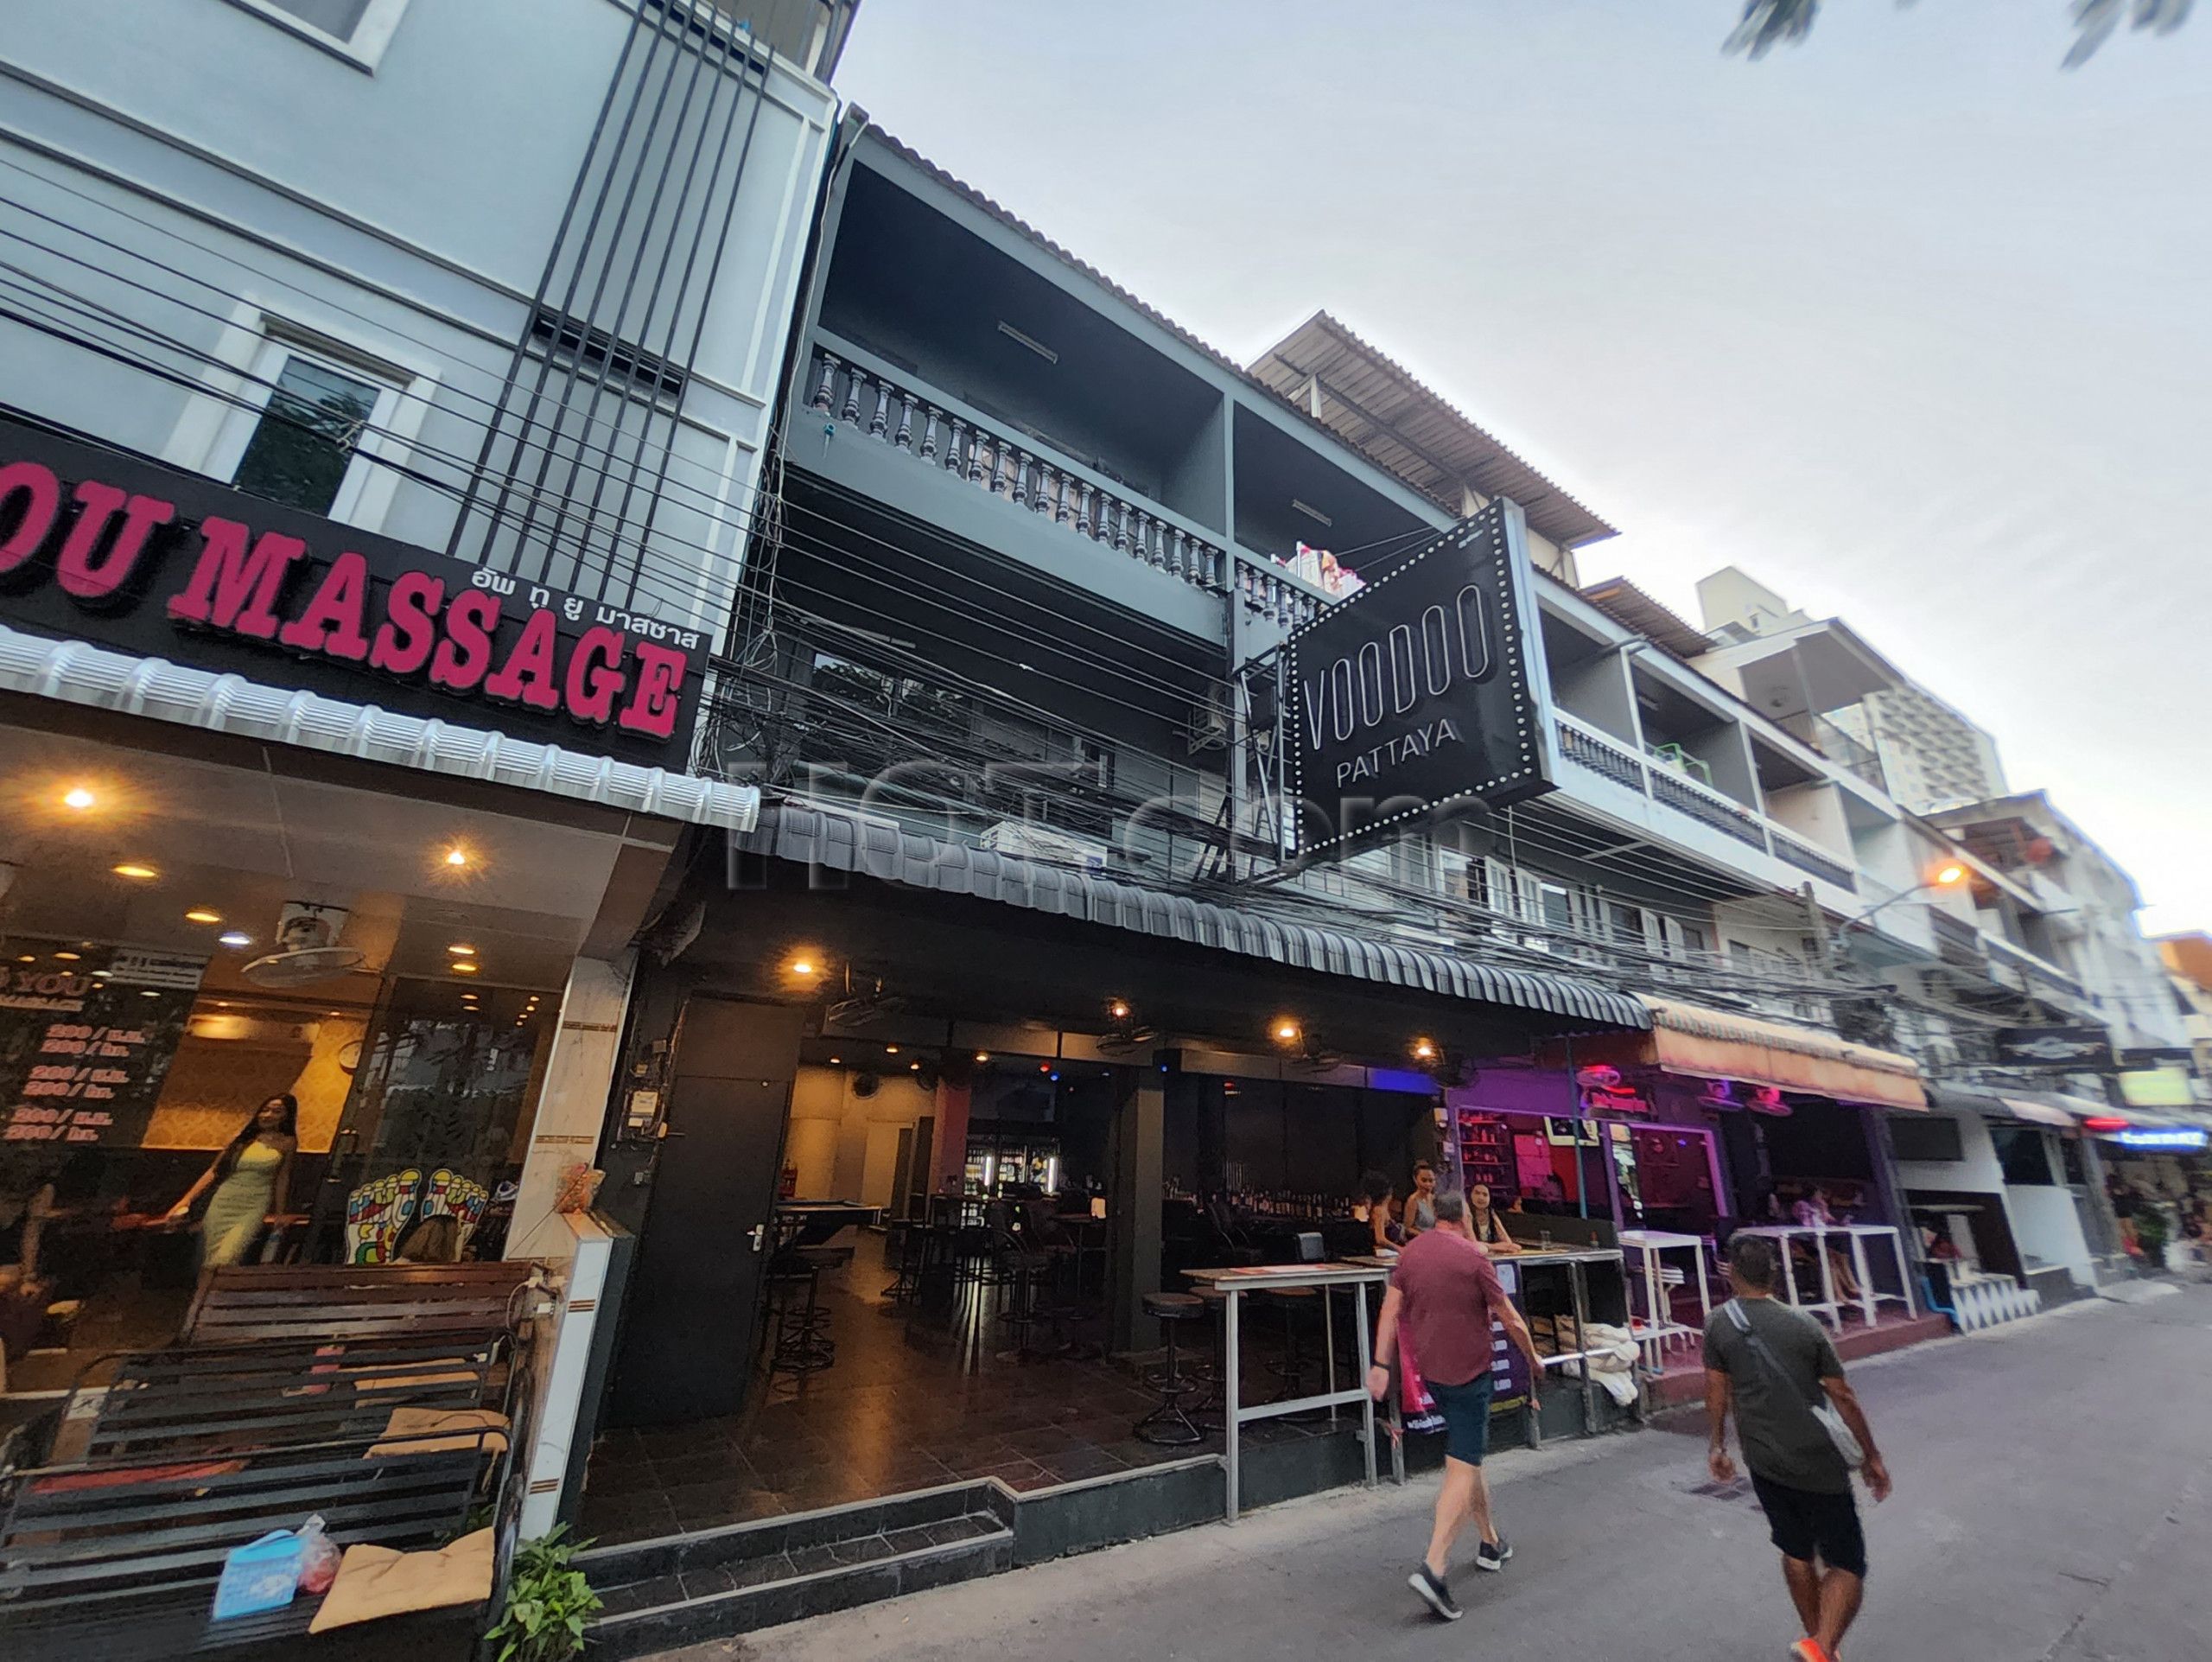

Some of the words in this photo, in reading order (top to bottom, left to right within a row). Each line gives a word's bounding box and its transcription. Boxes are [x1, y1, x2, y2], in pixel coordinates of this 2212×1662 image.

[168, 517, 687, 737] MASSAGE
[472, 567, 517, 595] อัพ
[563, 597, 584, 621] ยู
[1303, 584, 1490, 750] VOODOO
[1336, 717, 1457, 788] PATTAYA
